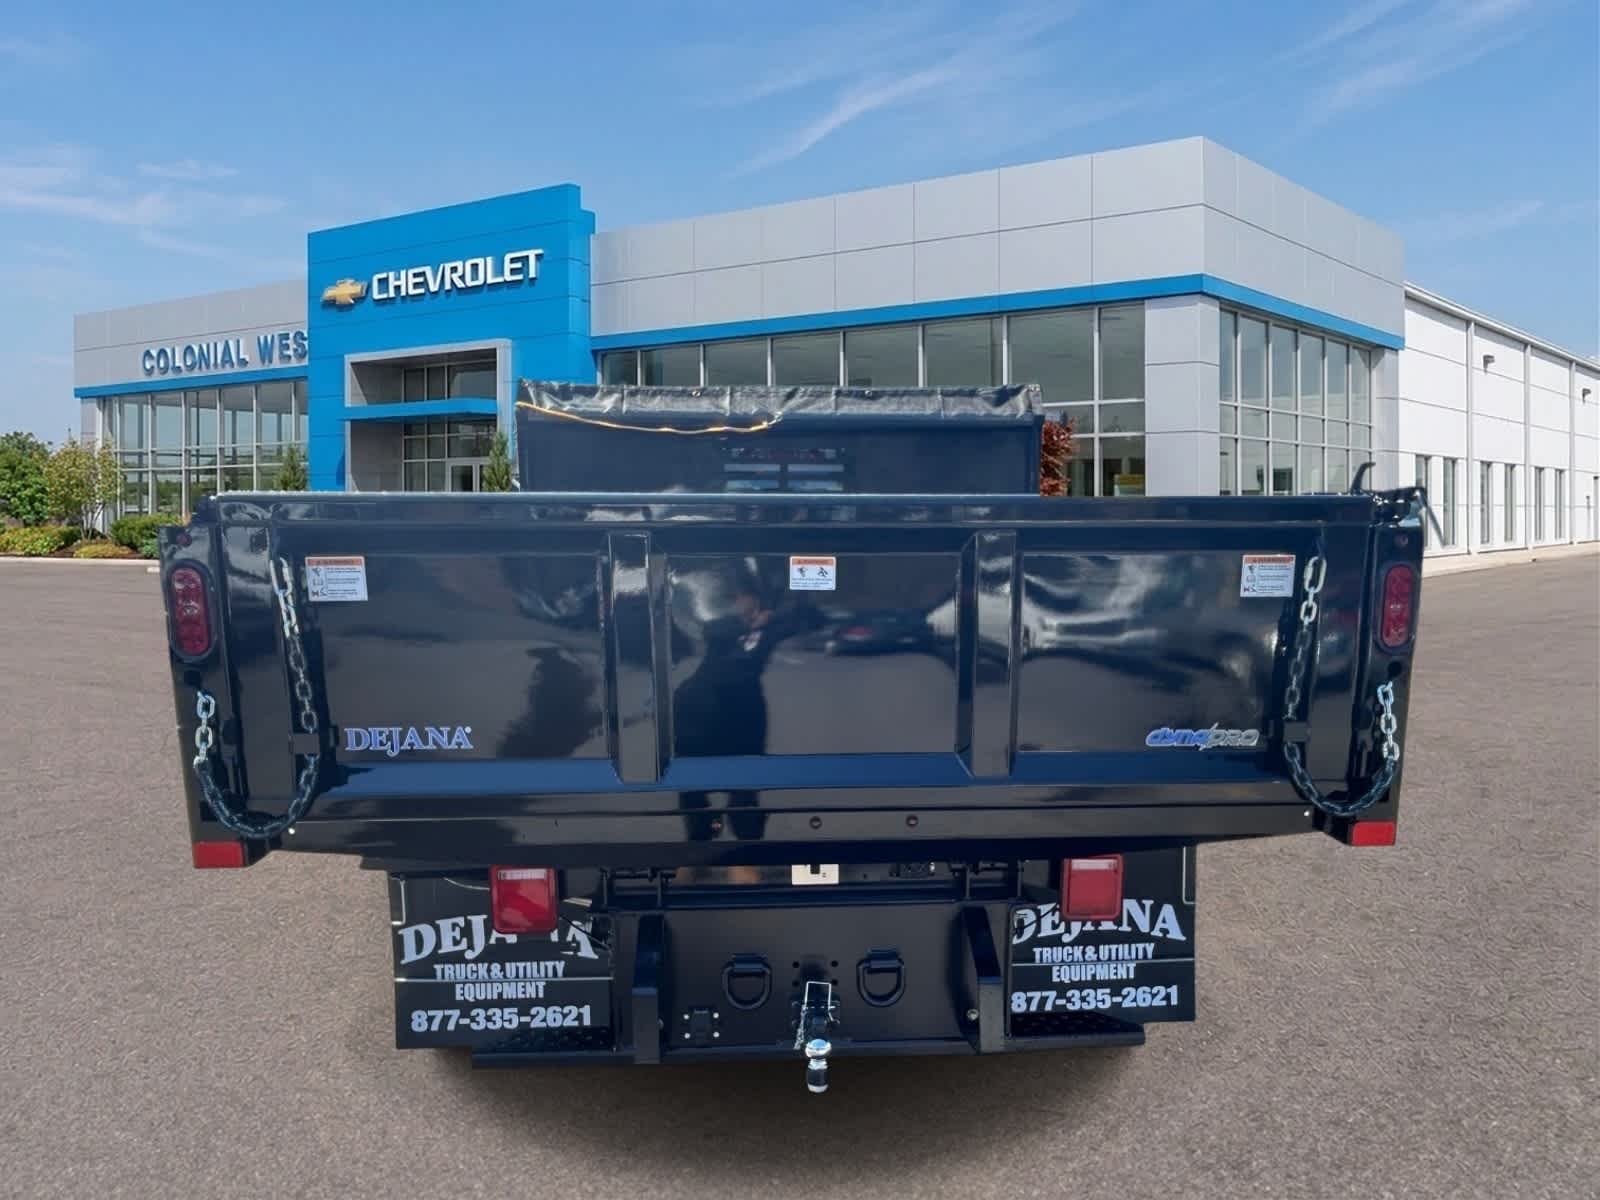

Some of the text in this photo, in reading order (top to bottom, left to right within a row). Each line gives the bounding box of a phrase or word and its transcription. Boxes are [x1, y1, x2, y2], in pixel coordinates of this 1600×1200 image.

[372, 249, 544, 300] CHEVROLET
[142, 339, 249, 376] COLONIAL
[343, 726, 474, 757] DEJANA
[1012, 899, 1187, 944] DEJNA
[398, 914, 598, 964] DEJA
[1052, 963, 1136, 983] EQUIPMENT
[455, 981, 546, 1002] EQUIPMENT
[1011, 985, 1179, 1013] 877-335-2621
[411, 1005, 591, 1032] 877-335-2621
